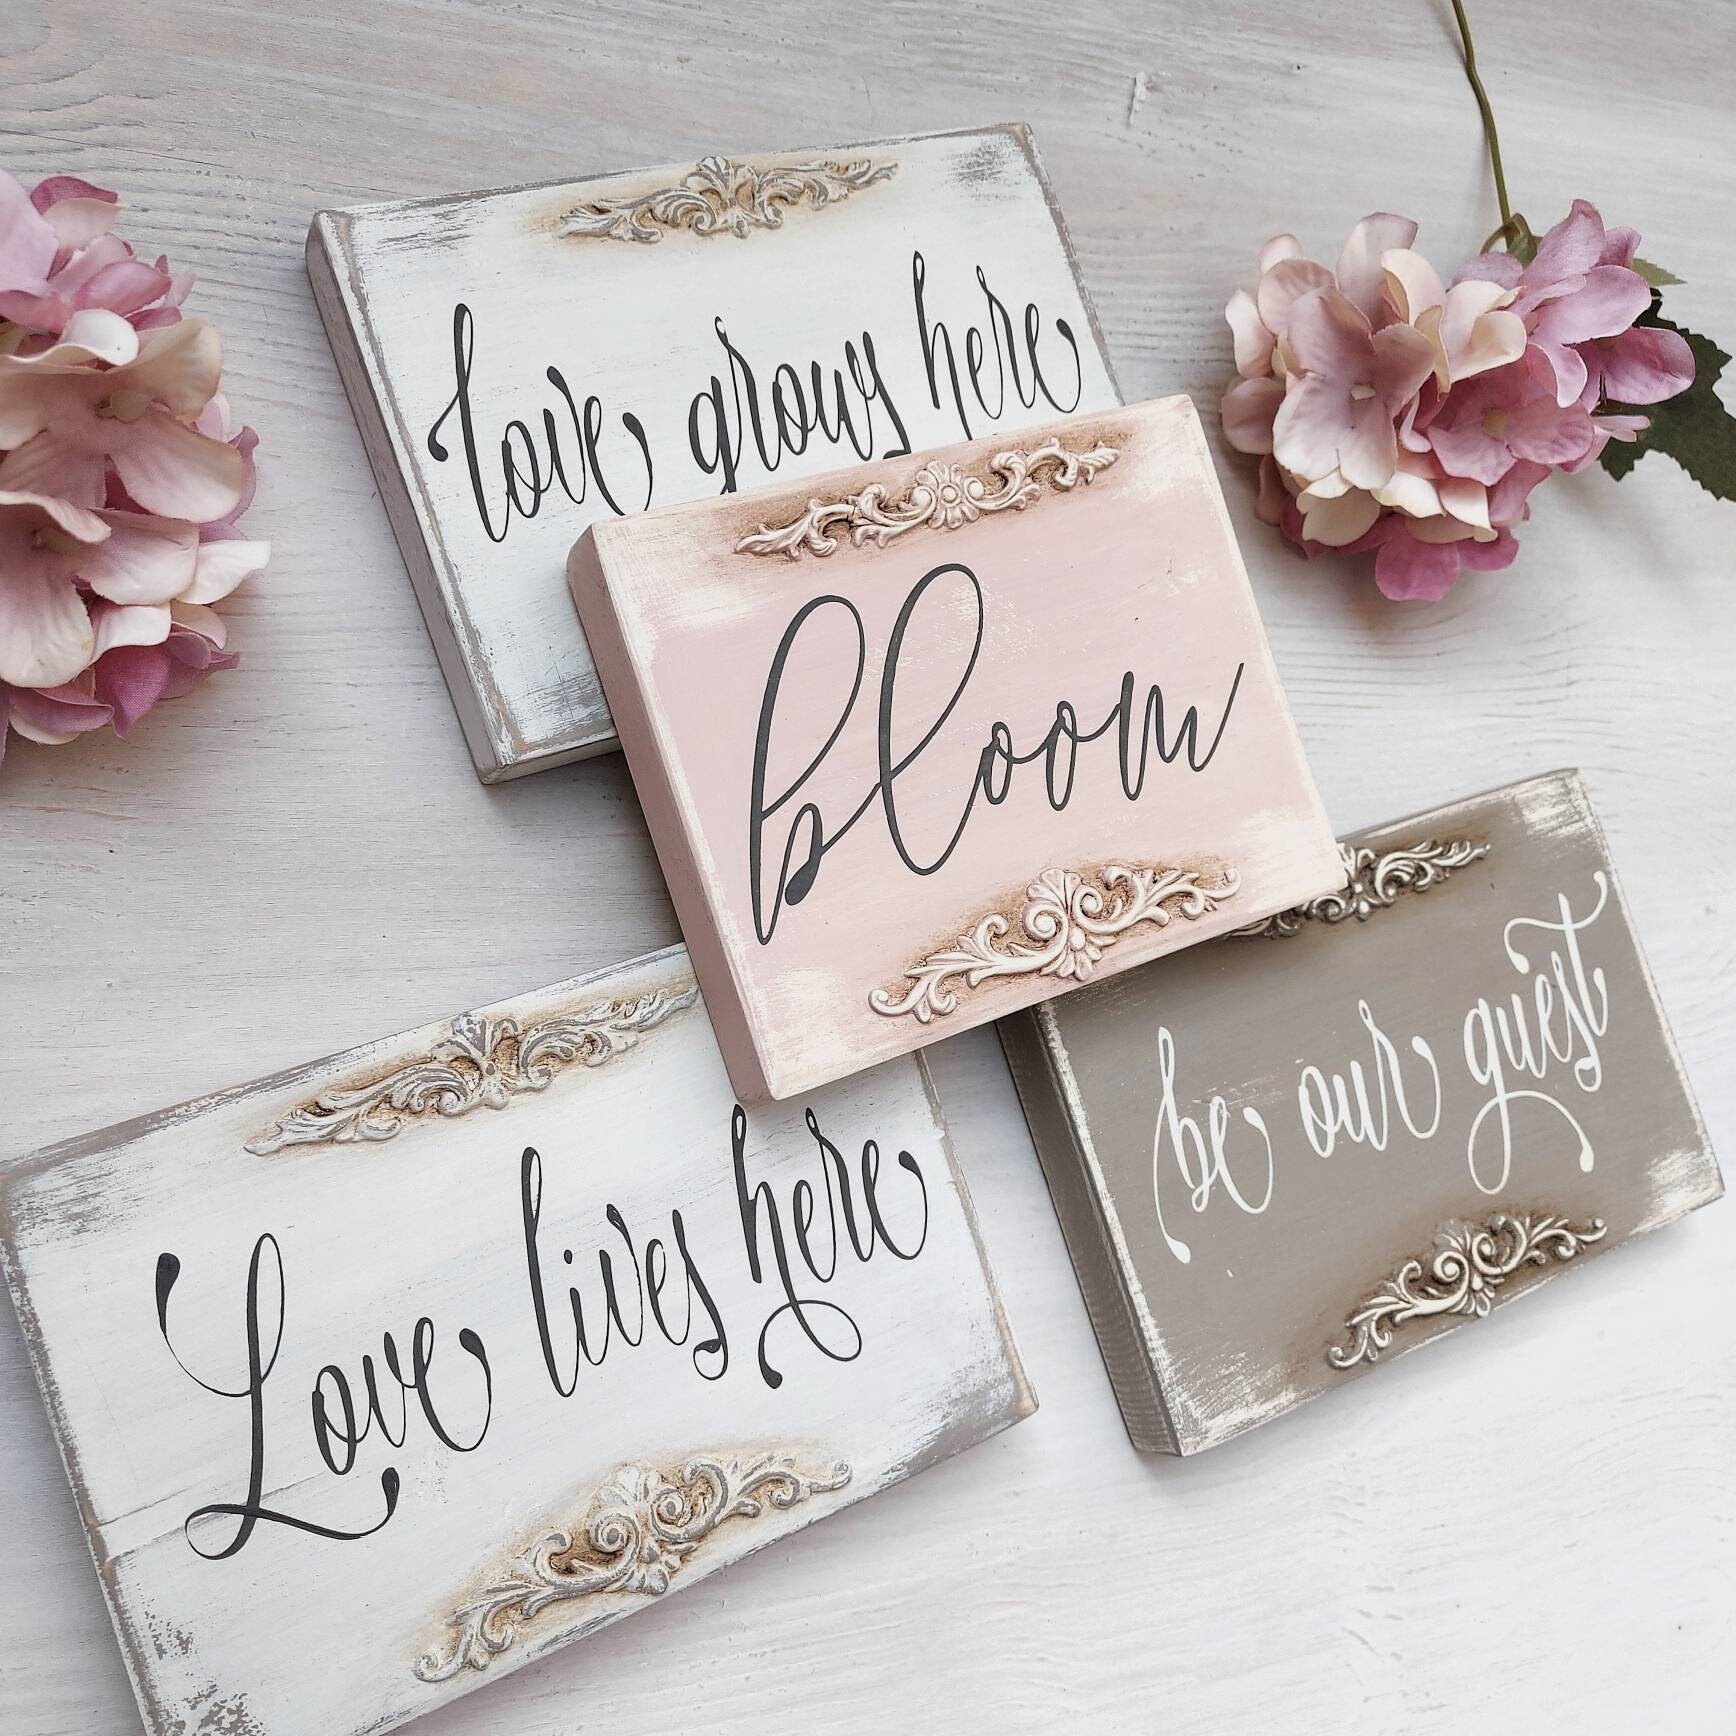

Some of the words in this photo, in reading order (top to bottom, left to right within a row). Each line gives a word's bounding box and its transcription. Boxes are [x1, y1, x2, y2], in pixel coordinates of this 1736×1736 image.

[428, 303, 653, 543] love
[688, 316, 912, 495] grows
[912, 250, 1082, 441] here
[750, 563, 1245, 945] bloom
[1153, 1026, 1273, 1265] be
[1299, 999, 1441, 1158] our
[1463, 870, 1609, 1195] guest
[155, 1232, 492, 1560] Love
[521, 1146, 729, 1397] lives
[731, 1104, 929, 1390] here
